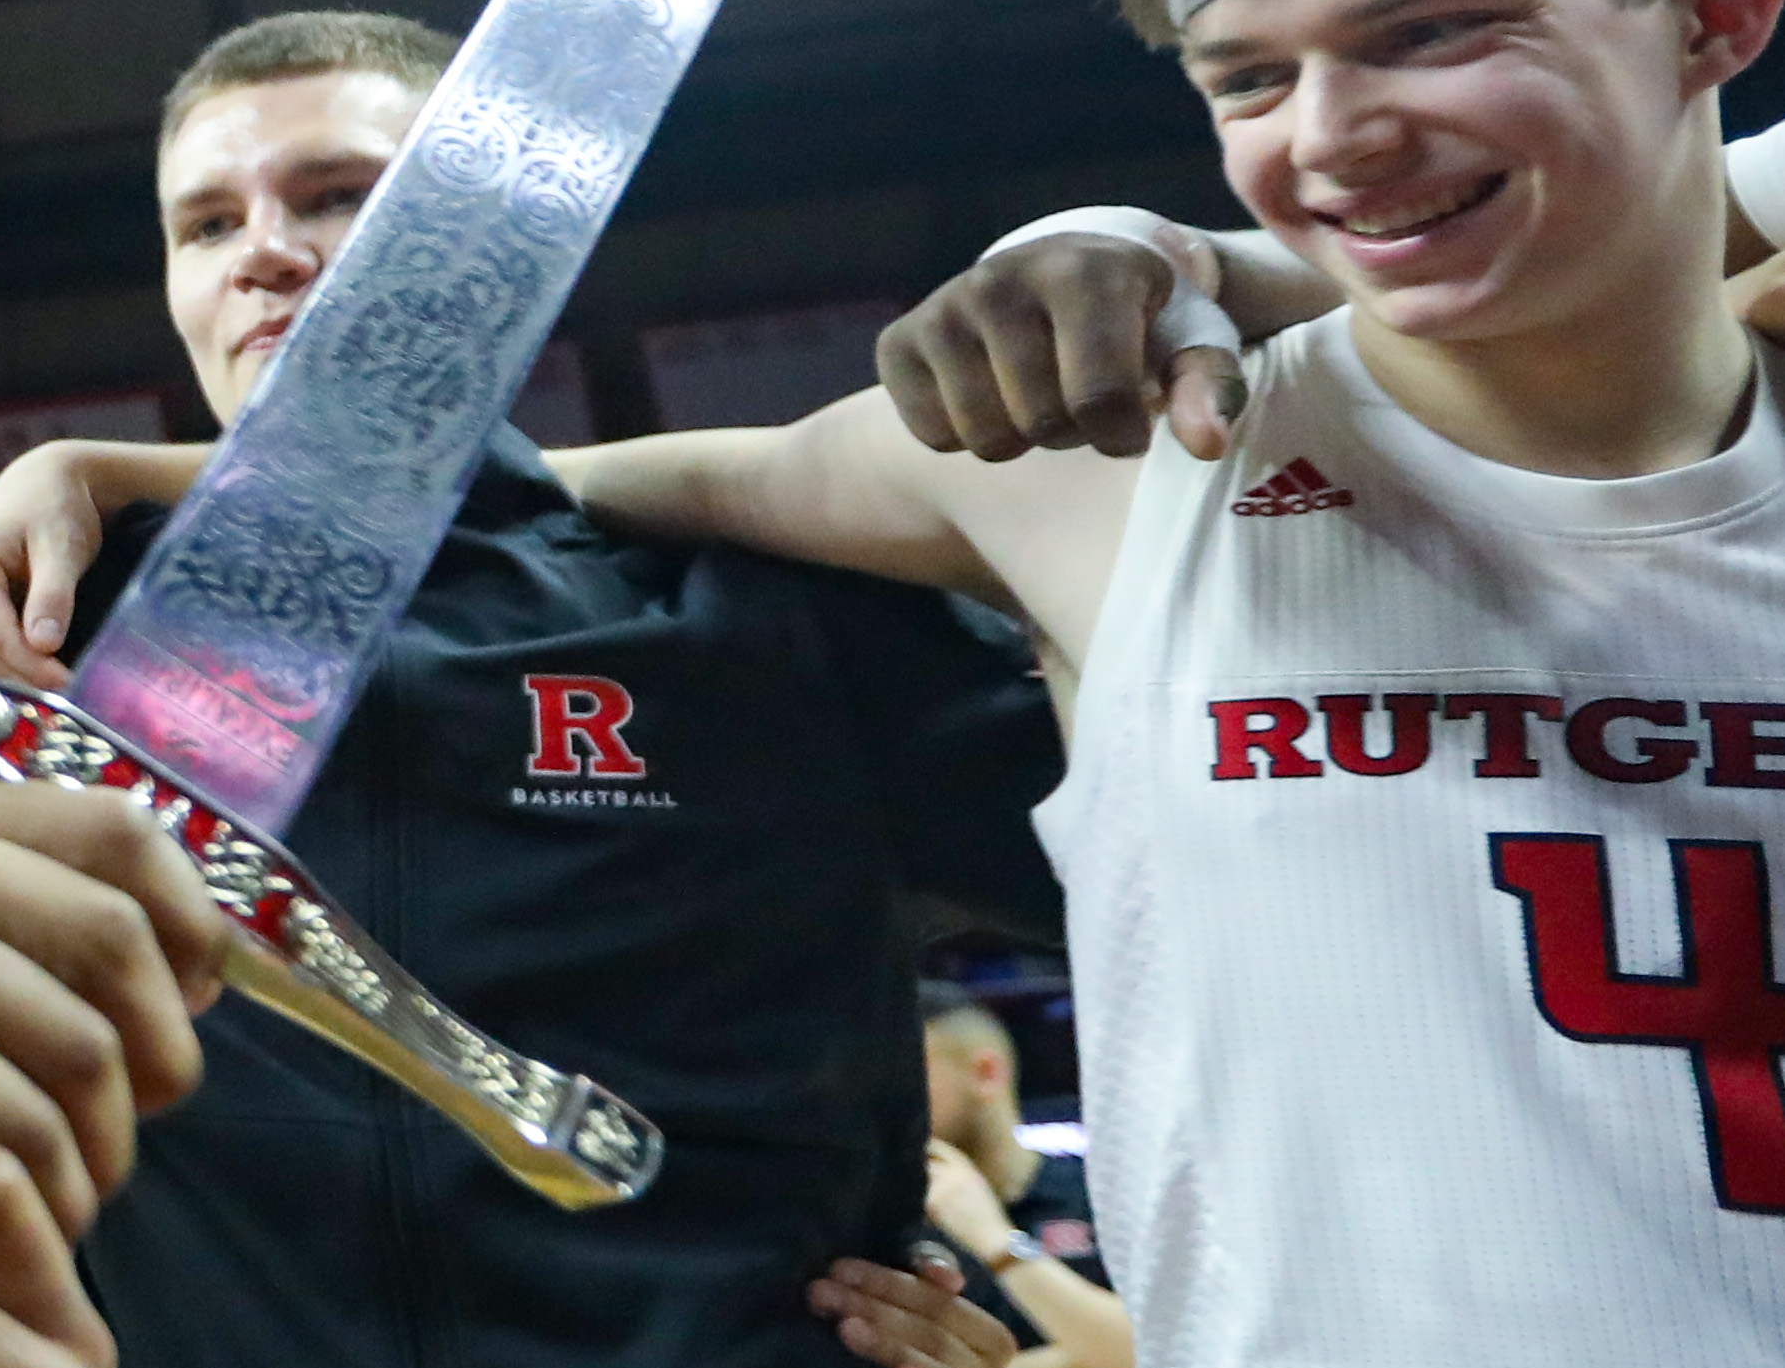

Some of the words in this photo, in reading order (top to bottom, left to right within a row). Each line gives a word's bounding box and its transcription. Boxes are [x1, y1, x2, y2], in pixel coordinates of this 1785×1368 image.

[1231, 488, 1355, 517] adidas
[524, 673, 646, 779] R
[512, 787, 678, 809] BASKETBALL
[1488, 831, 1785, 1216] 4
